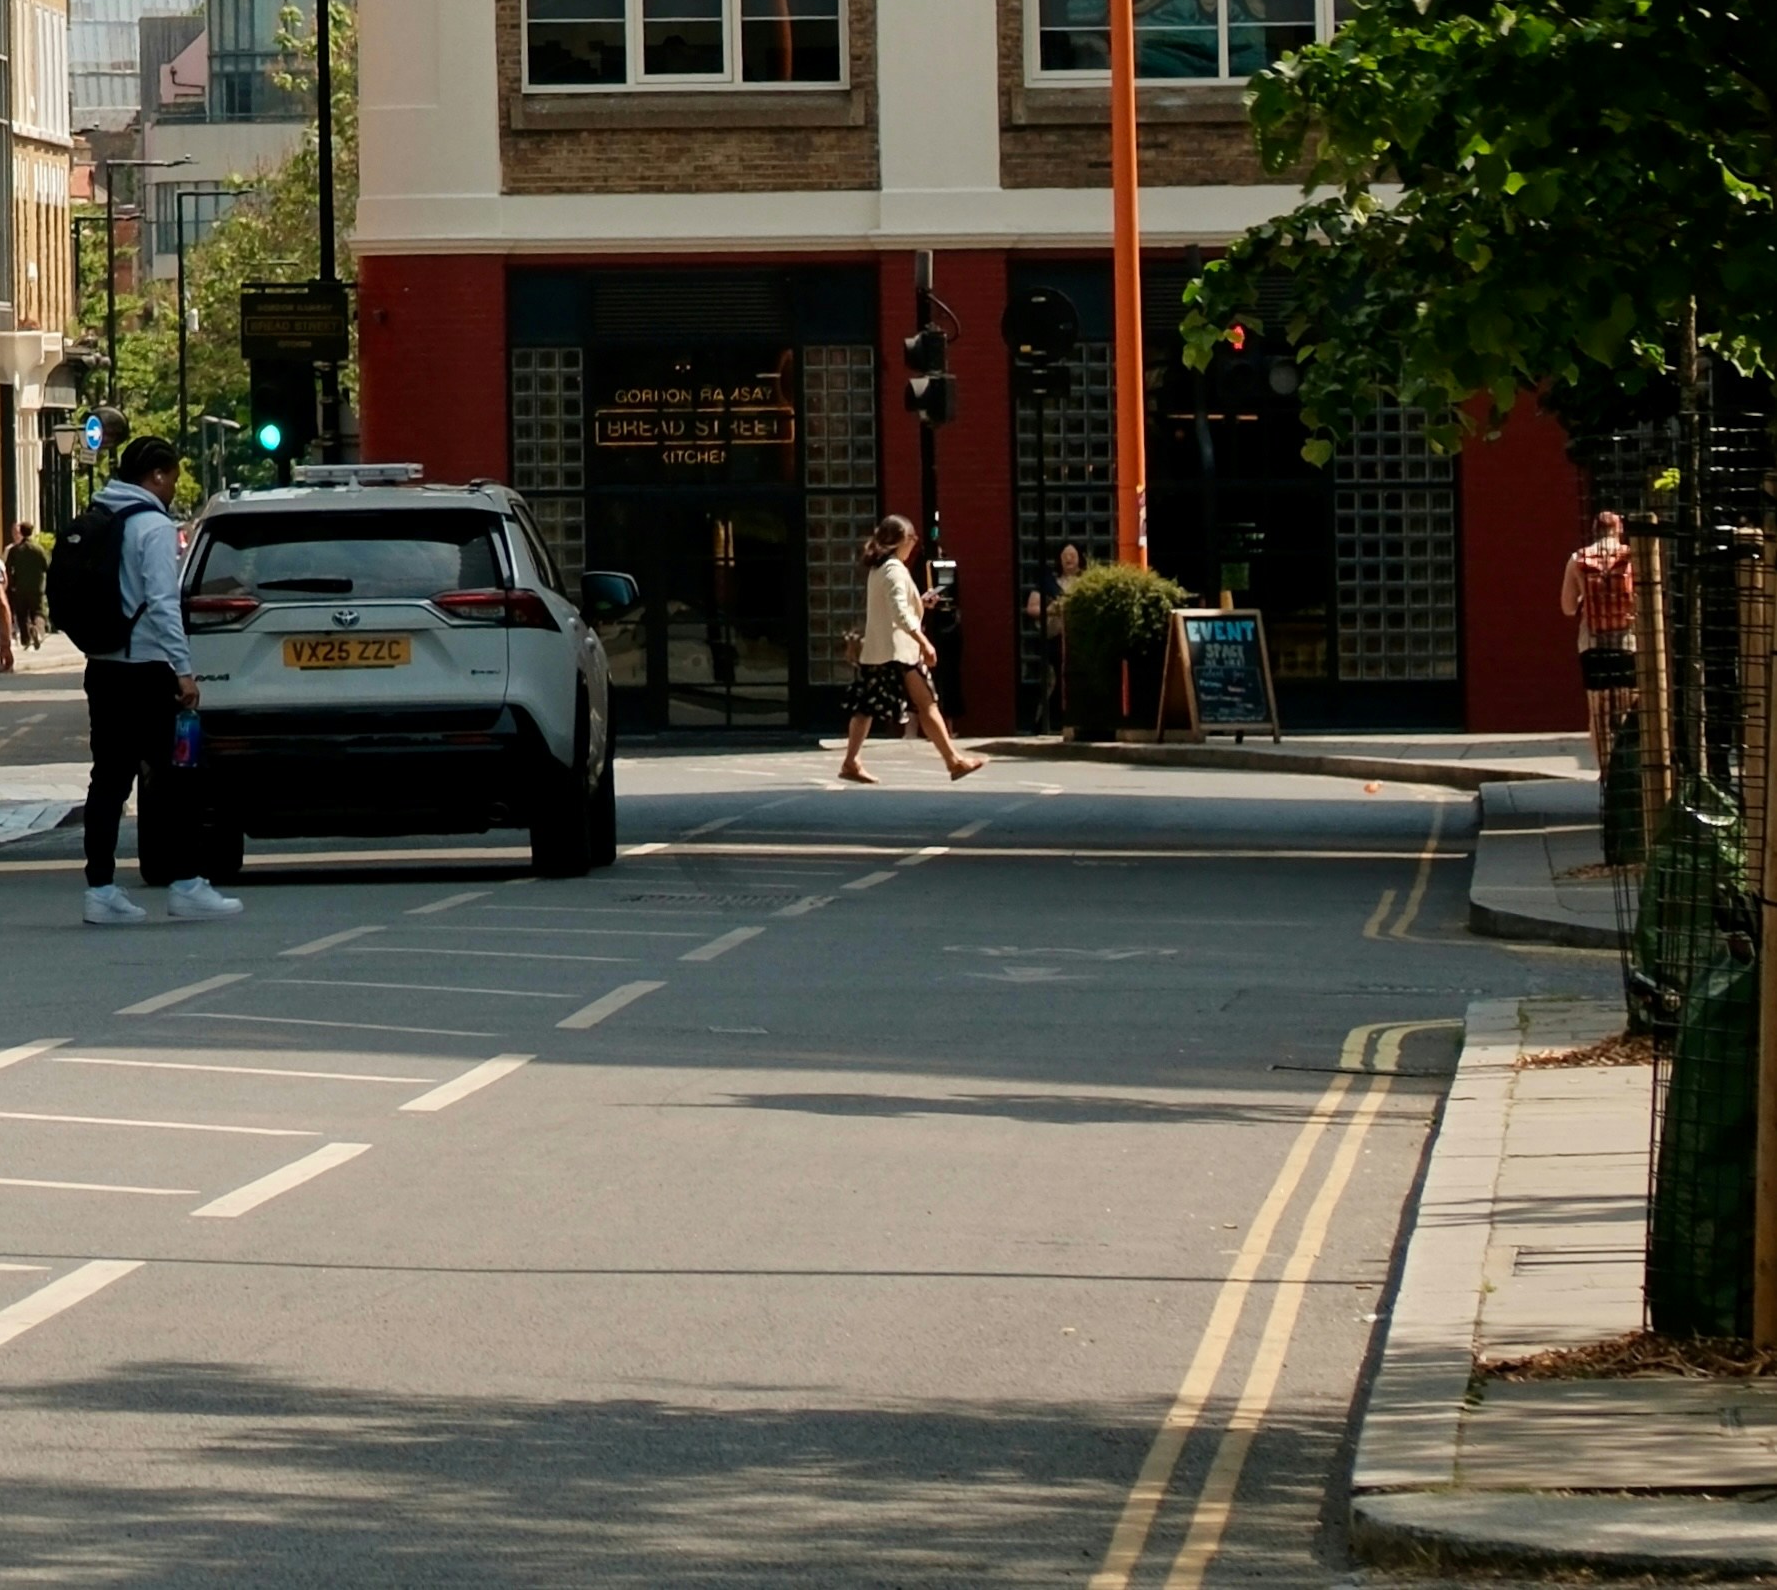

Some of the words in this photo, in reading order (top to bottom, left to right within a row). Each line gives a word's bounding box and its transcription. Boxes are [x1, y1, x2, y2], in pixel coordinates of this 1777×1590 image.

[614, 388, 692, 404] GORDON
[699, 386, 772, 402] RAMSAY
[607, 419, 685, 437] BREAD
[1186, 620, 1255, 642] EVENT
[291, 640, 352, 663] VX25
[357, 639, 402, 662] ZZC
[1205, 643, 1244, 658] SPACE
